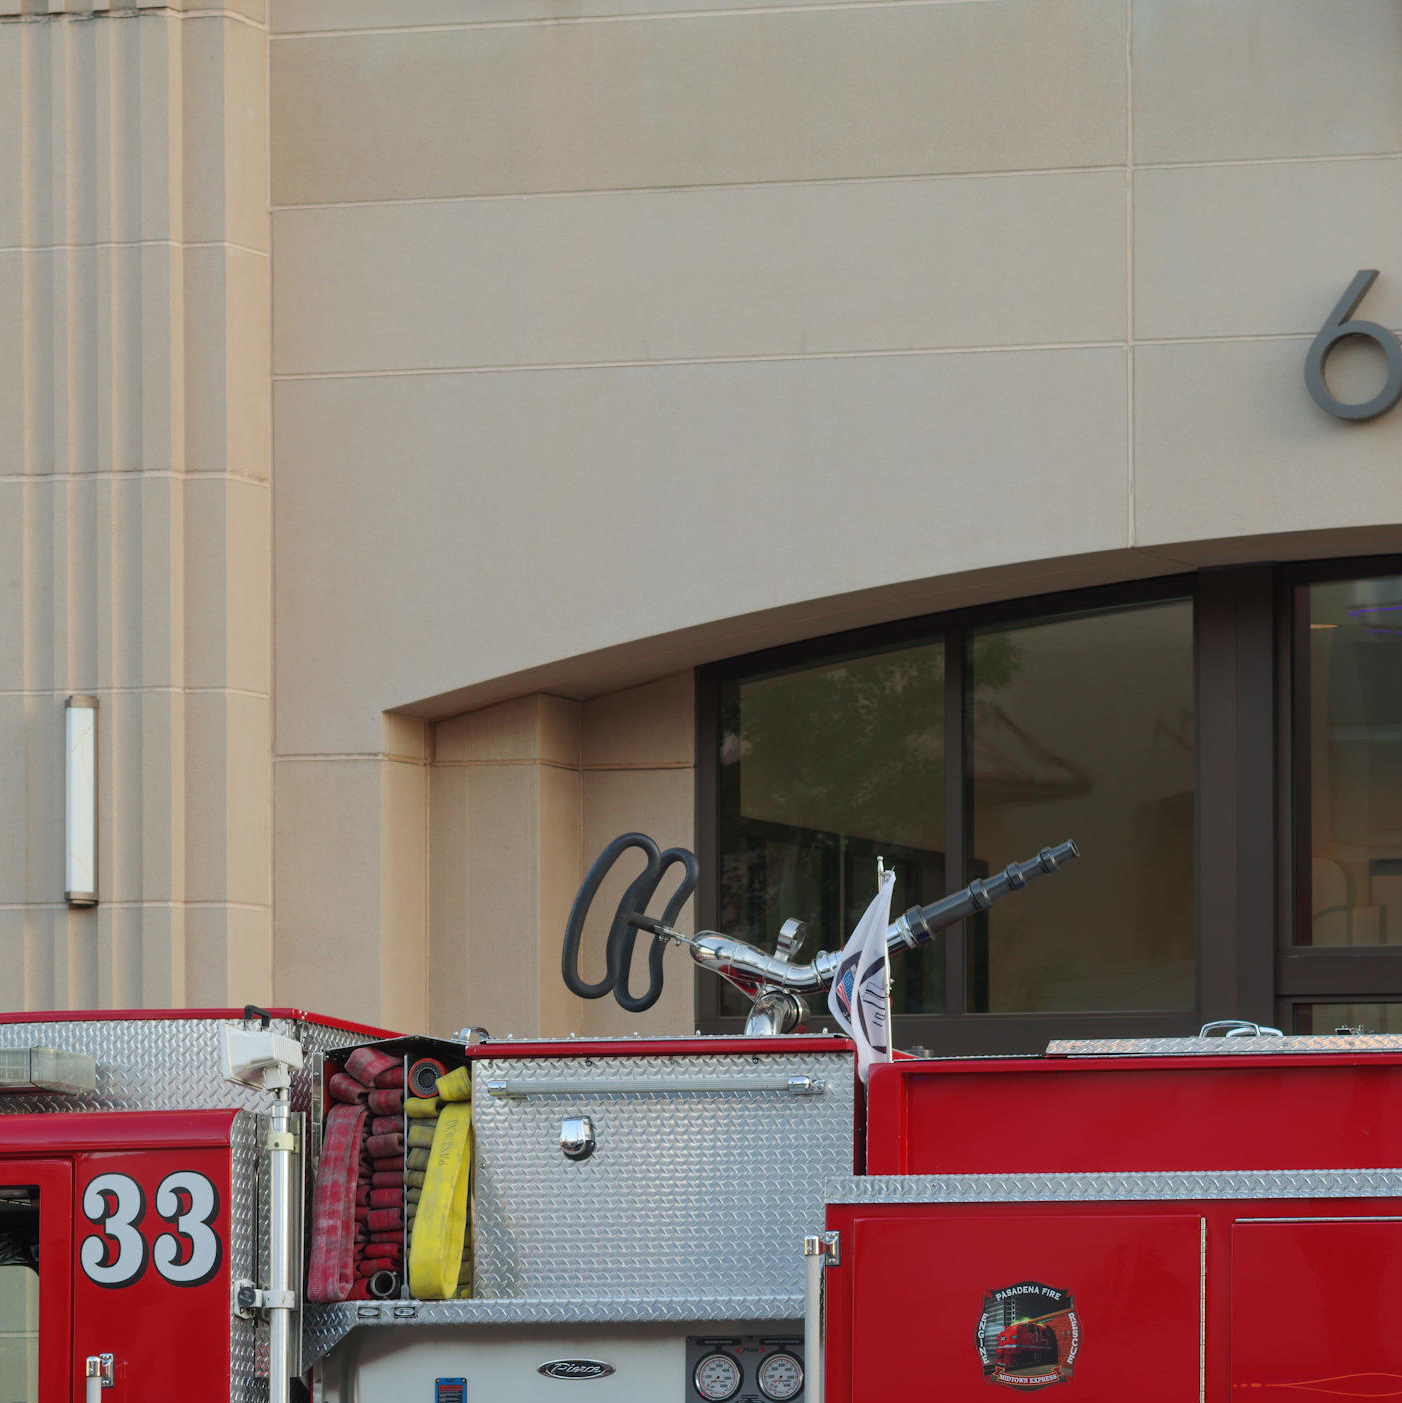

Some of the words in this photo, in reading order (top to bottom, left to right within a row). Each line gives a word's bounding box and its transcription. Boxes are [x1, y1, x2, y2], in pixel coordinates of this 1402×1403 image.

[80, 1170, 223, 1289] 33
[995, 1286, 1040, 1301] PASADENA
[1041, 1288, 1062, 1301] FIRE
[977, 1312, 990, 1365] ENGINE
[1066, 1312, 1079, 1365] RESCUE
[998, 1373, 1028, 1384] MIDTOWN
[1029, 1373, 1058, 1384] EXPRESS
